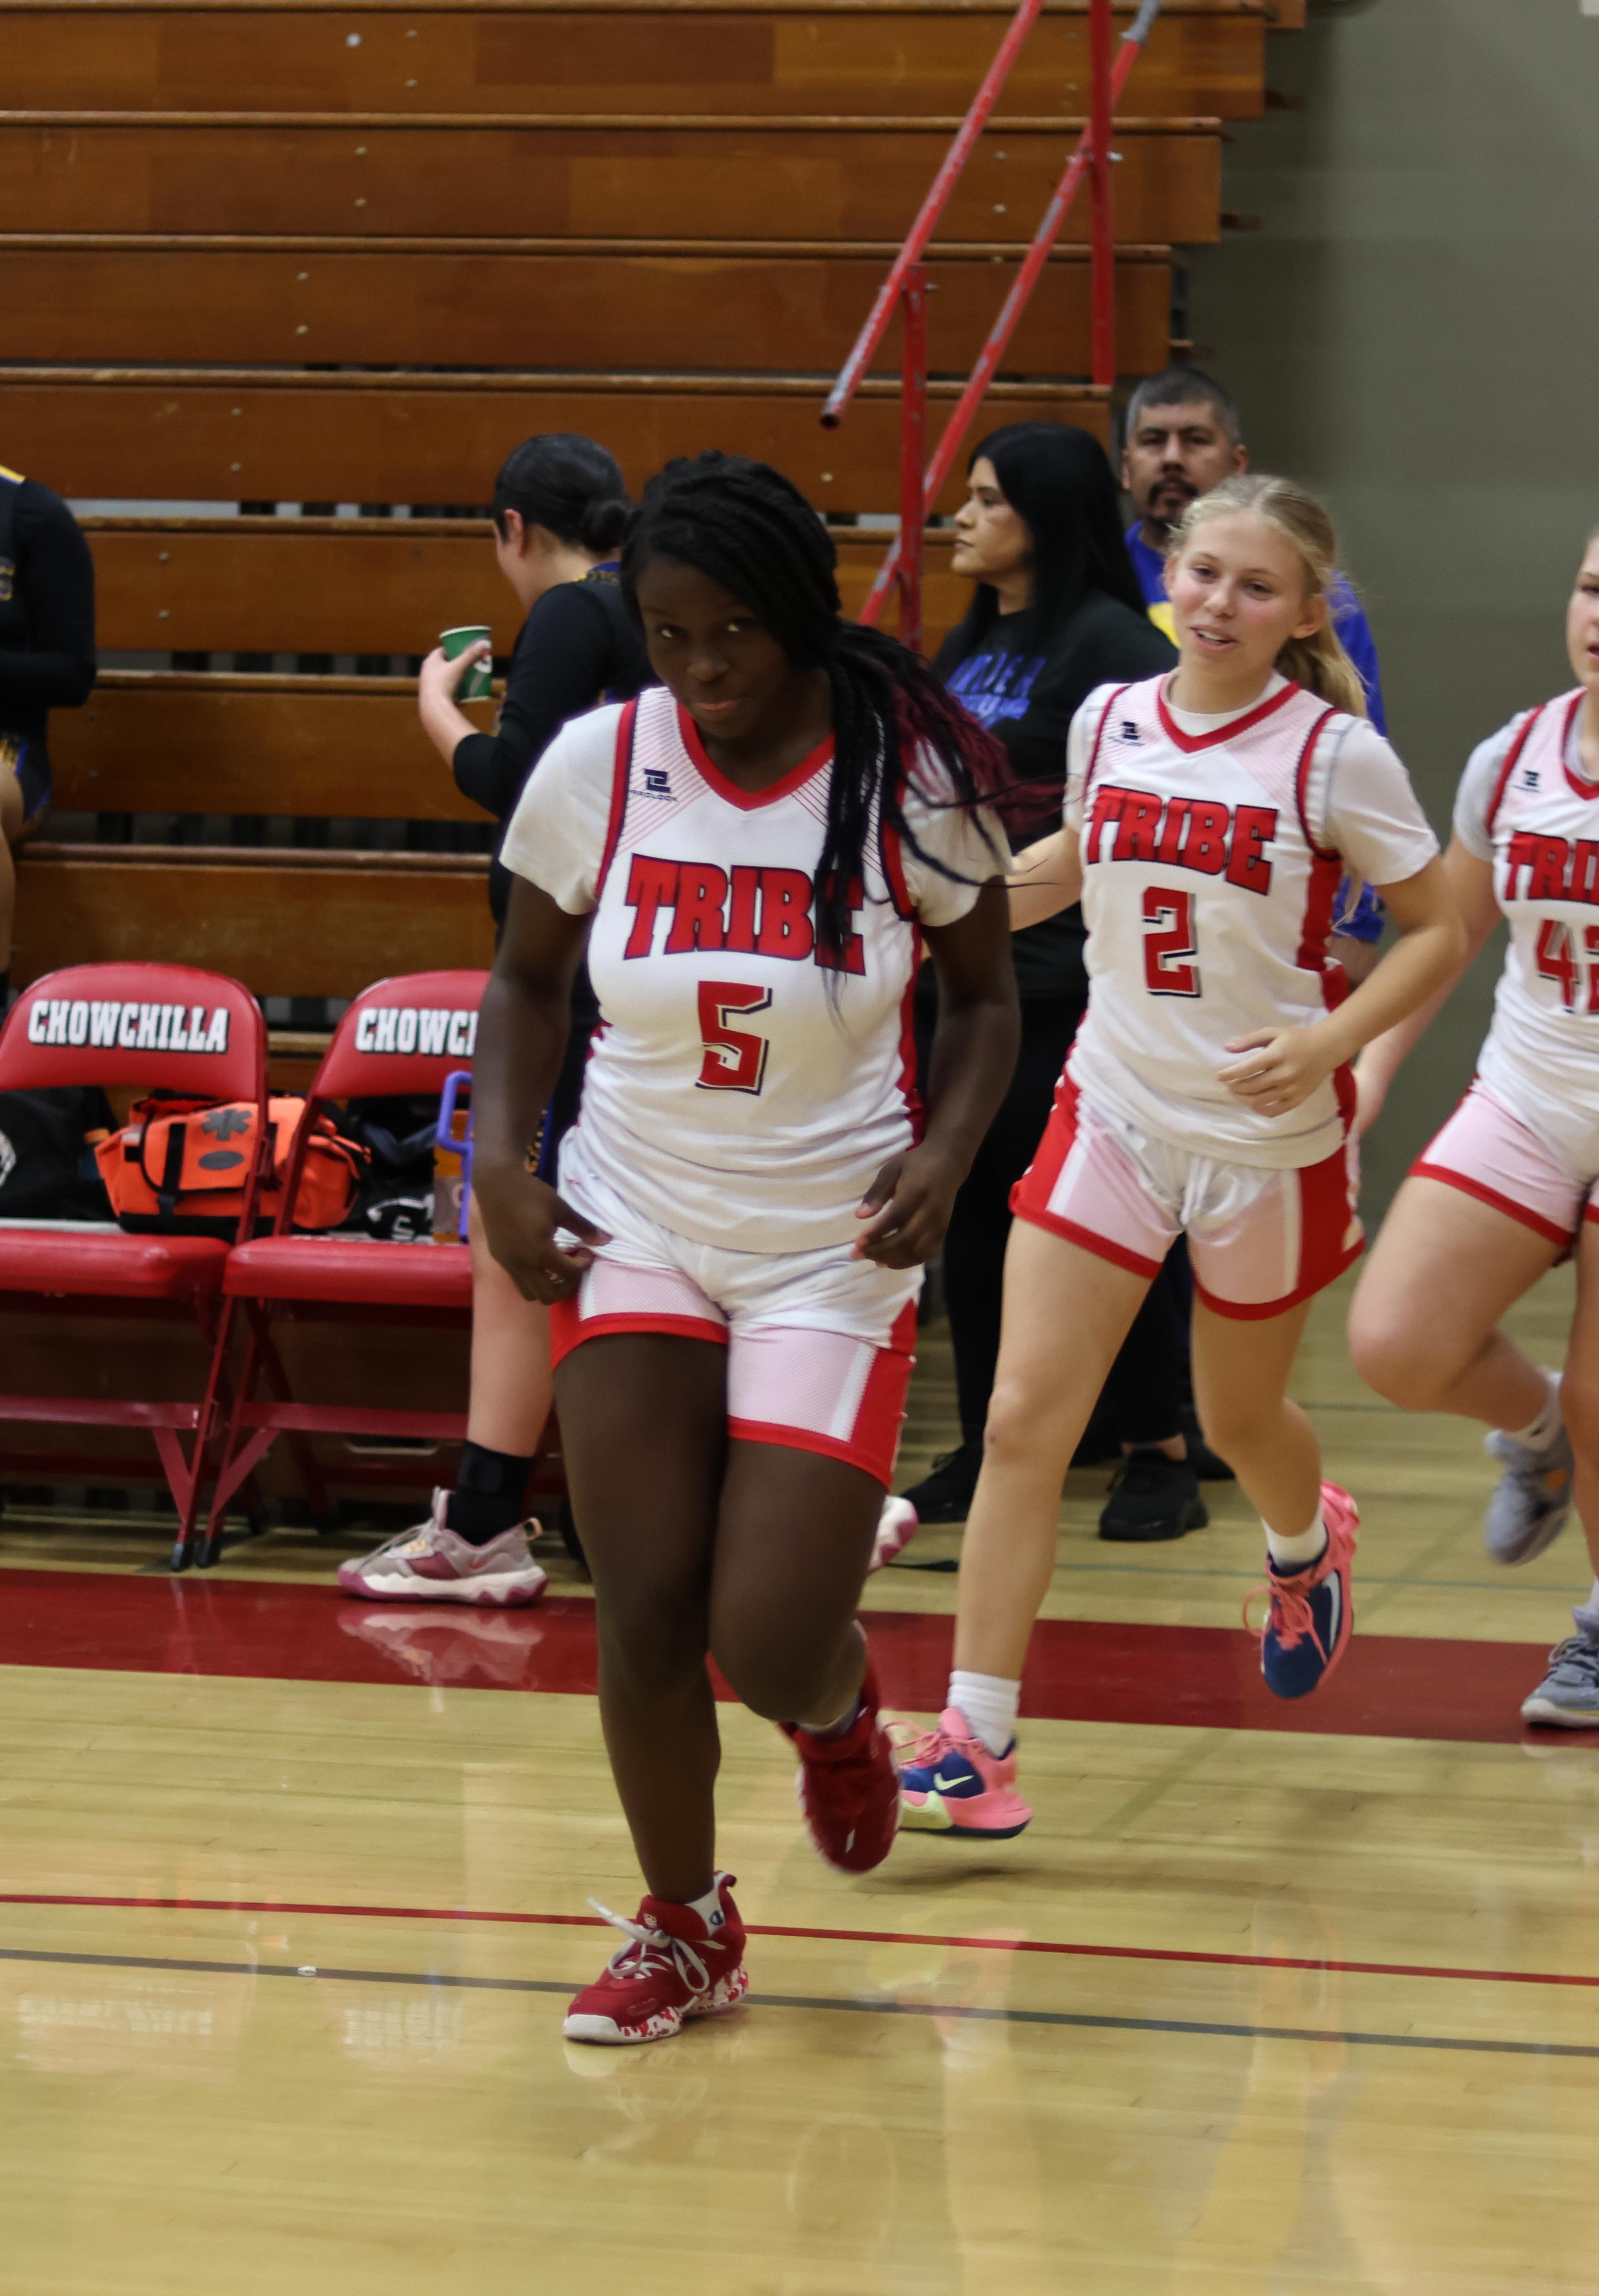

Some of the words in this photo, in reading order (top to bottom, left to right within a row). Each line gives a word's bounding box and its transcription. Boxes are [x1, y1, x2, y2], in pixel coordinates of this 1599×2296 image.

[1085, 784, 1279, 896] TRIBE
[1505, 830, 1599, 906] TRI
[1142, 886, 1201, 998] 2
[28, 1000, 229, 1053] CHOWCHILLA
[696, 981, 772, 1096] 5
